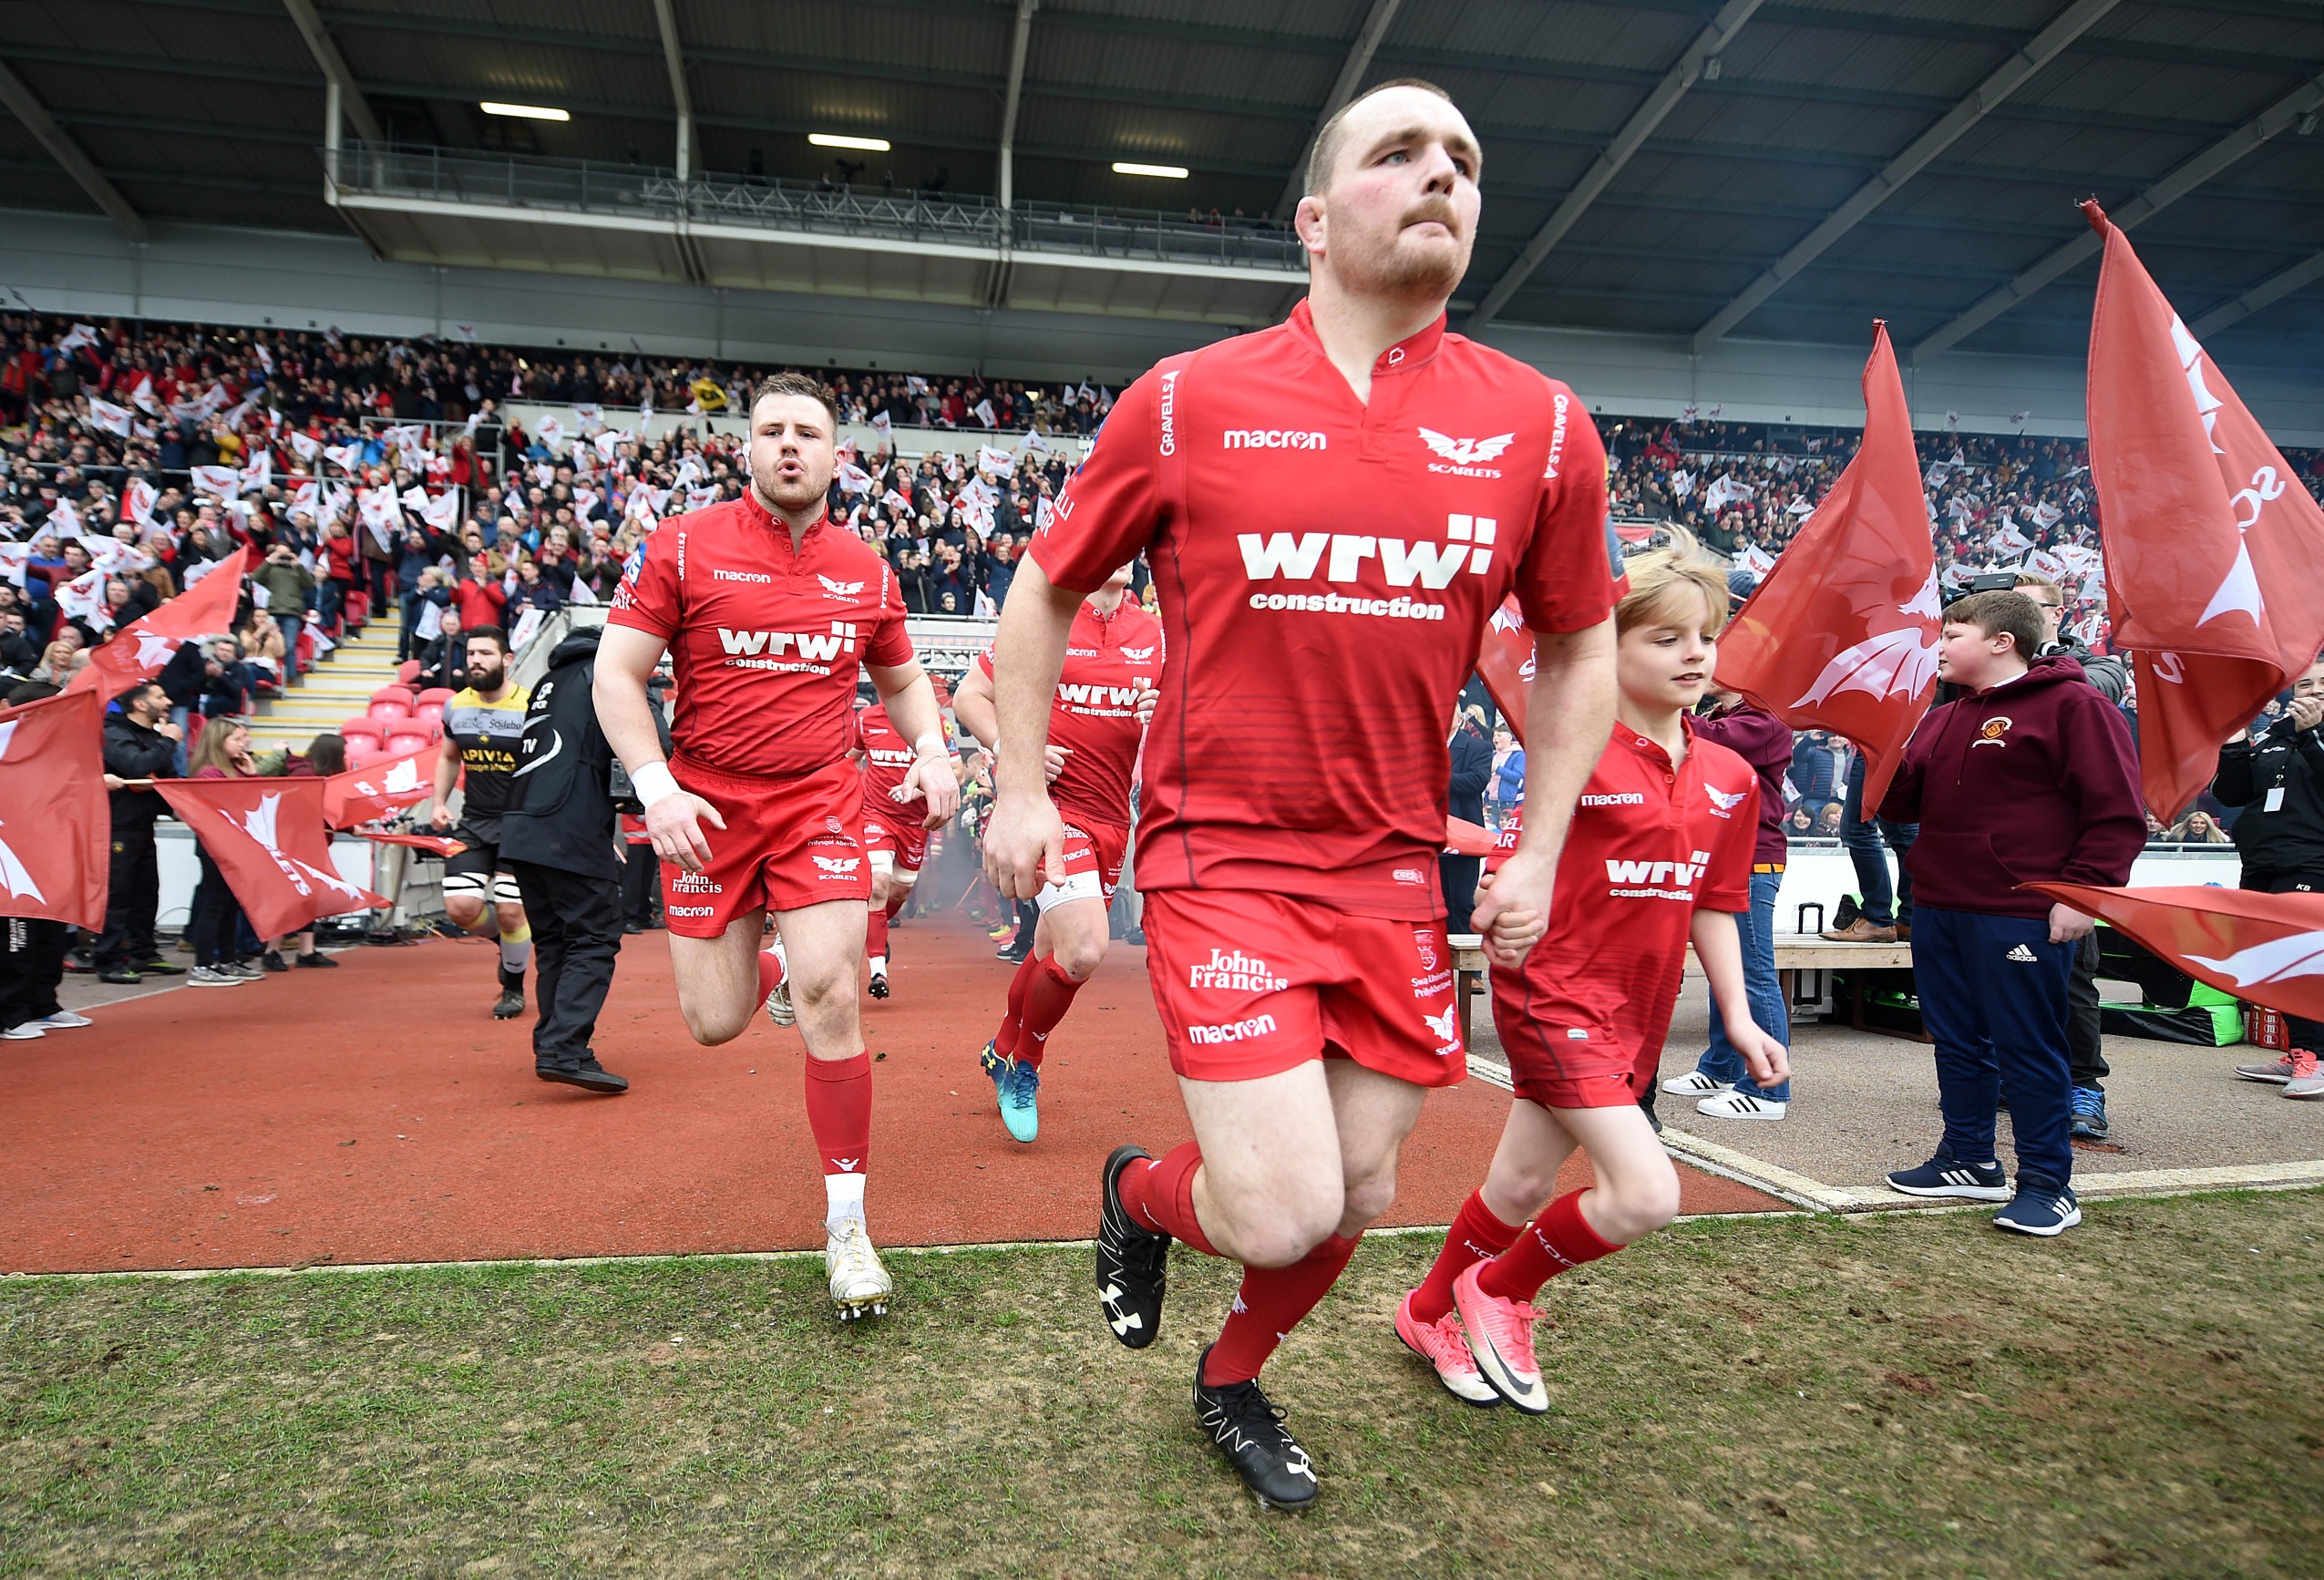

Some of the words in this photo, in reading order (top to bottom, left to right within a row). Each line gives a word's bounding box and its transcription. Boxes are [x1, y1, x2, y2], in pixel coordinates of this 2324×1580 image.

[1159, 383, 1176, 457] GRAVELLS
[1548, 394, 1569, 465] GRAVELLS
[1223, 429, 1327, 450] macron
[1427, 462, 1502, 479] SCARLETS
[713, 569, 771, 584] macron
[822, 593, 859, 605] SCARLETS
[1249, 592, 1445, 621] construction
[725, 658, 832, 676] construction
[1581, 792, 1644, 806] macron
[678, 870, 709, 885] John
[818, 874, 859, 882] SCARLETS
[672, 878, 723, 894] Francis
[2296, 883, 2311, 892] KB
[669, 905, 715, 918] macron
[1206, 949, 1266, 977] John
[2006, 954, 2038, 962] adidas
[1189, 964, 1289, 992] Francis
[1188, 1013, 1277, 1045] macron
